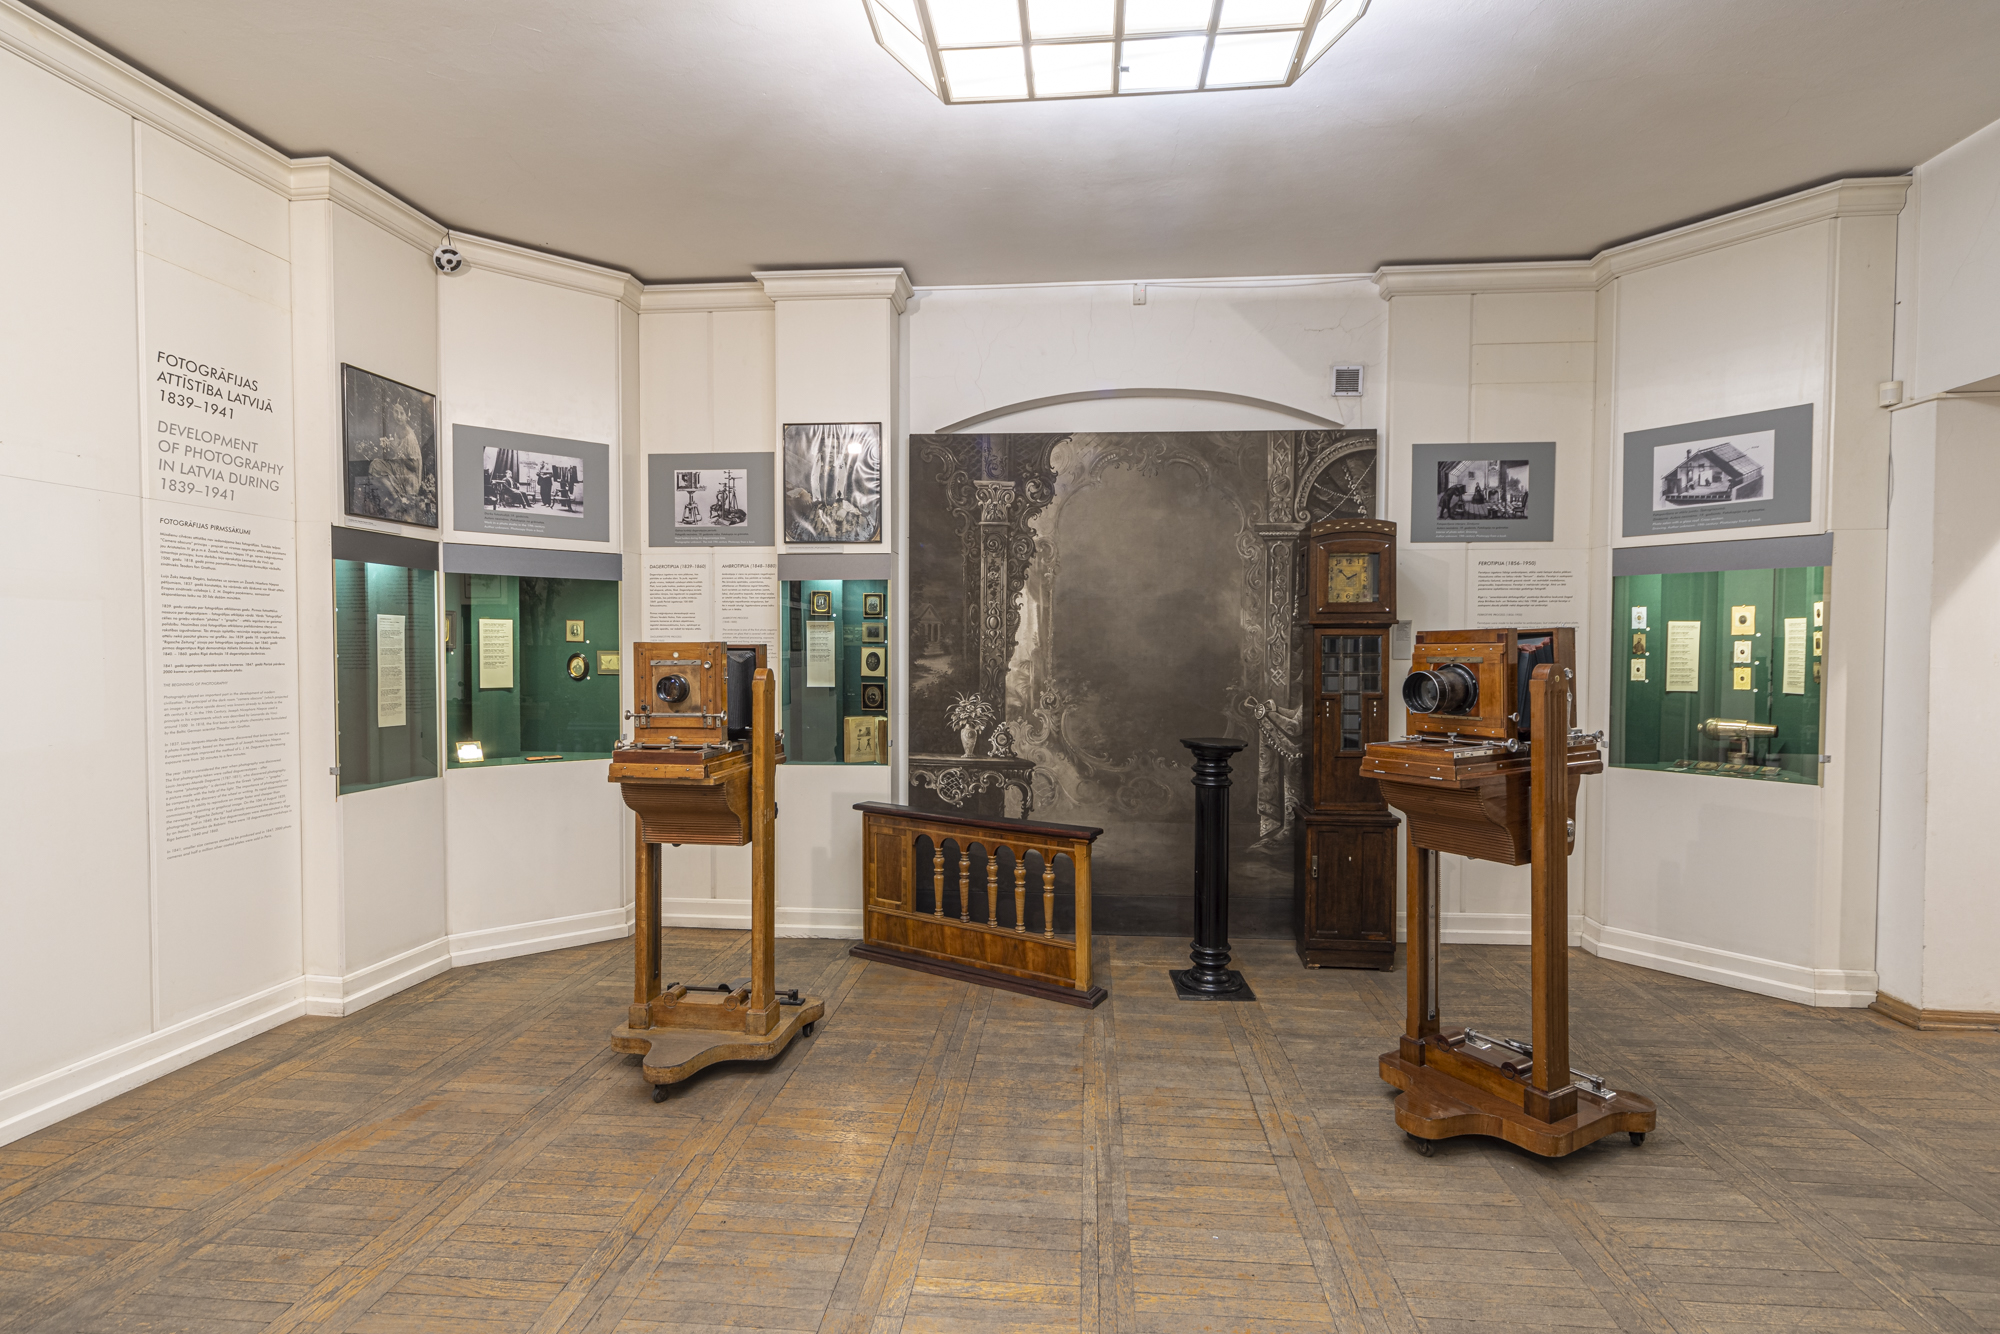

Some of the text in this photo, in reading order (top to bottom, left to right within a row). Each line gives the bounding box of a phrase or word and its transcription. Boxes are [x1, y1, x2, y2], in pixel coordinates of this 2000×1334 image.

[157, 351, 258, 391] FOTOGRĀFIJAS
[157, 371, 273, 413] ATTĪSTĪBA LATVIJĀ
[160, 389, 234, 419] 1839–1941
[157, 420, 258, 453] DEVELOPMENT
[158, 440, 284, 475] OF PHOTOGRAPHY
[158, 458, 280, 492] IN LATVIA DURING
[161, 477, 235, 501] 1839–1941
[159, 518, 251, 535] FOTOGRĀFIJAS PIRMSSĀKUMI
